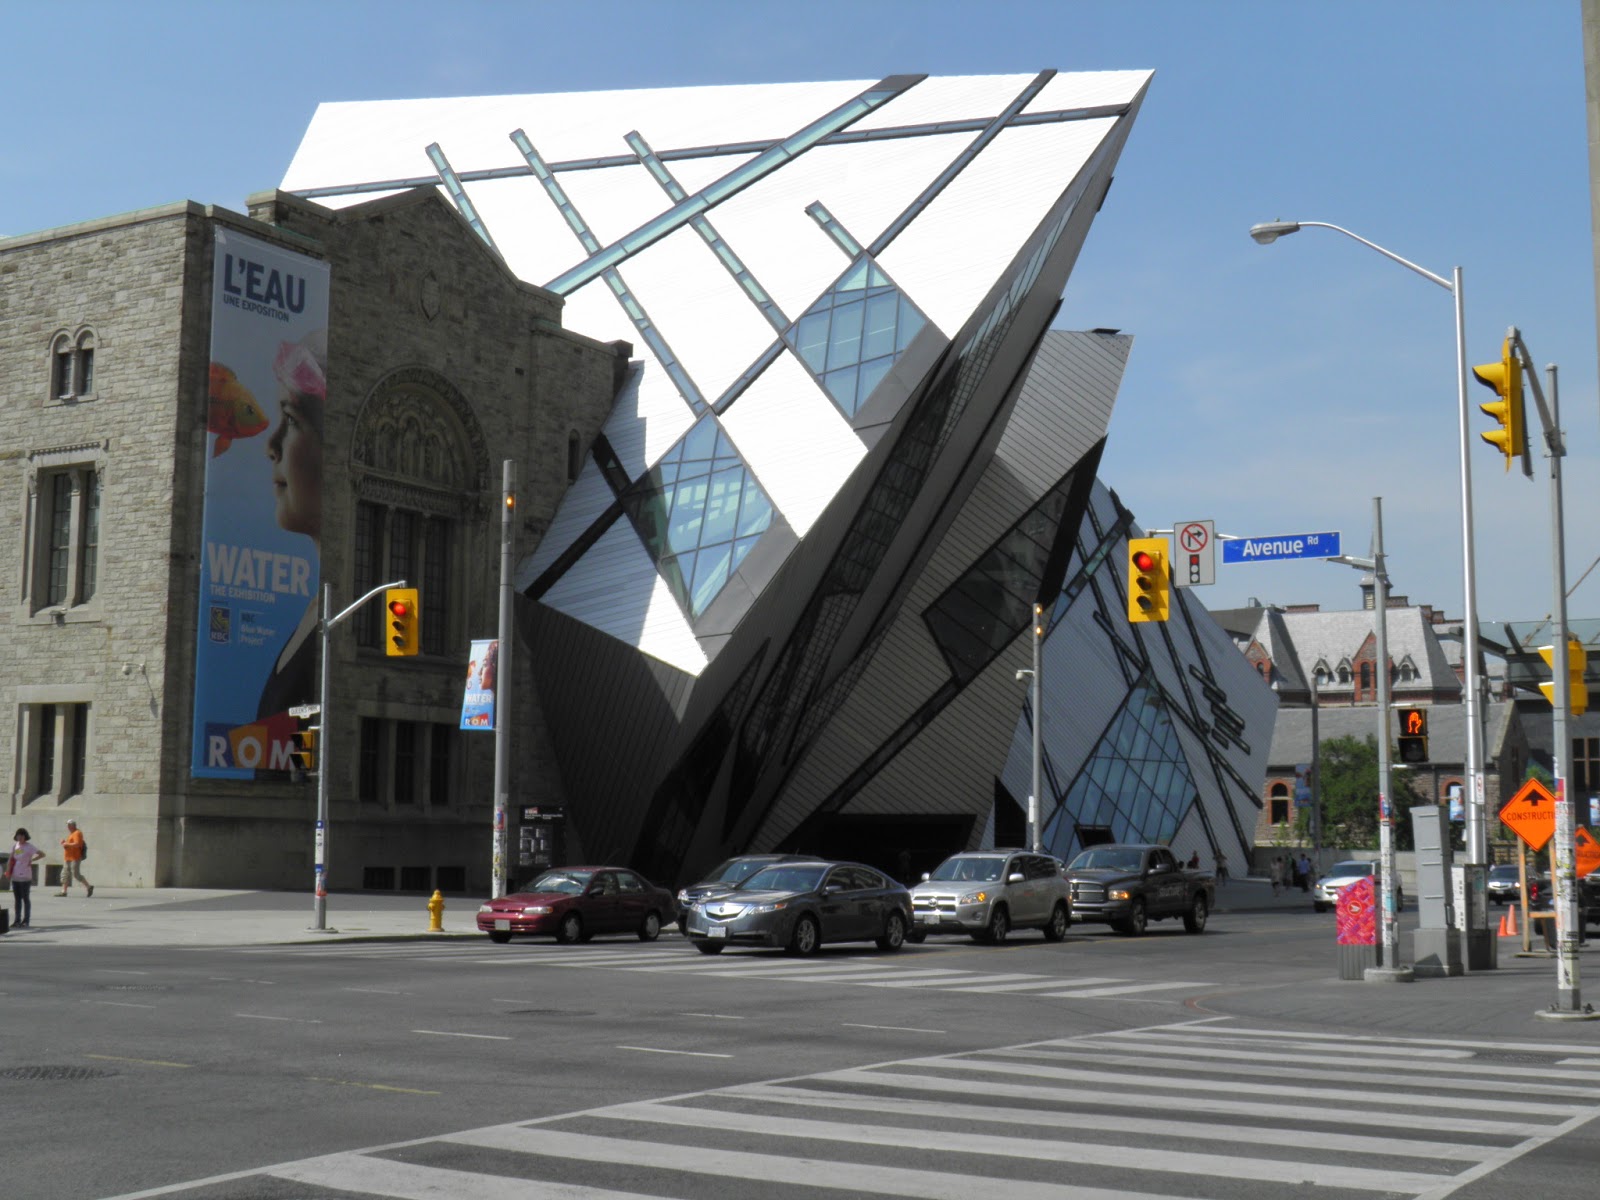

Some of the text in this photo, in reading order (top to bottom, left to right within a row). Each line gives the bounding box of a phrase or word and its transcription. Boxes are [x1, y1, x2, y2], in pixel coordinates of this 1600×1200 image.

[224, 254, 306, 314] L'EAU
[223, 293, 290, 323] UNE EXPOSITION
[1242, 536, 1319, 557] Avenue Rd
[207, 542, 311, 597] WATER
[210, 584, 276, 604] THE EXHIBITION
[210, 631, 228, 641] RBC
[465, 718, 488, 726] ROM
[208, 736, 296, 771] ROM
[1506, 811, 1555, 821] CONSTRUCTI
